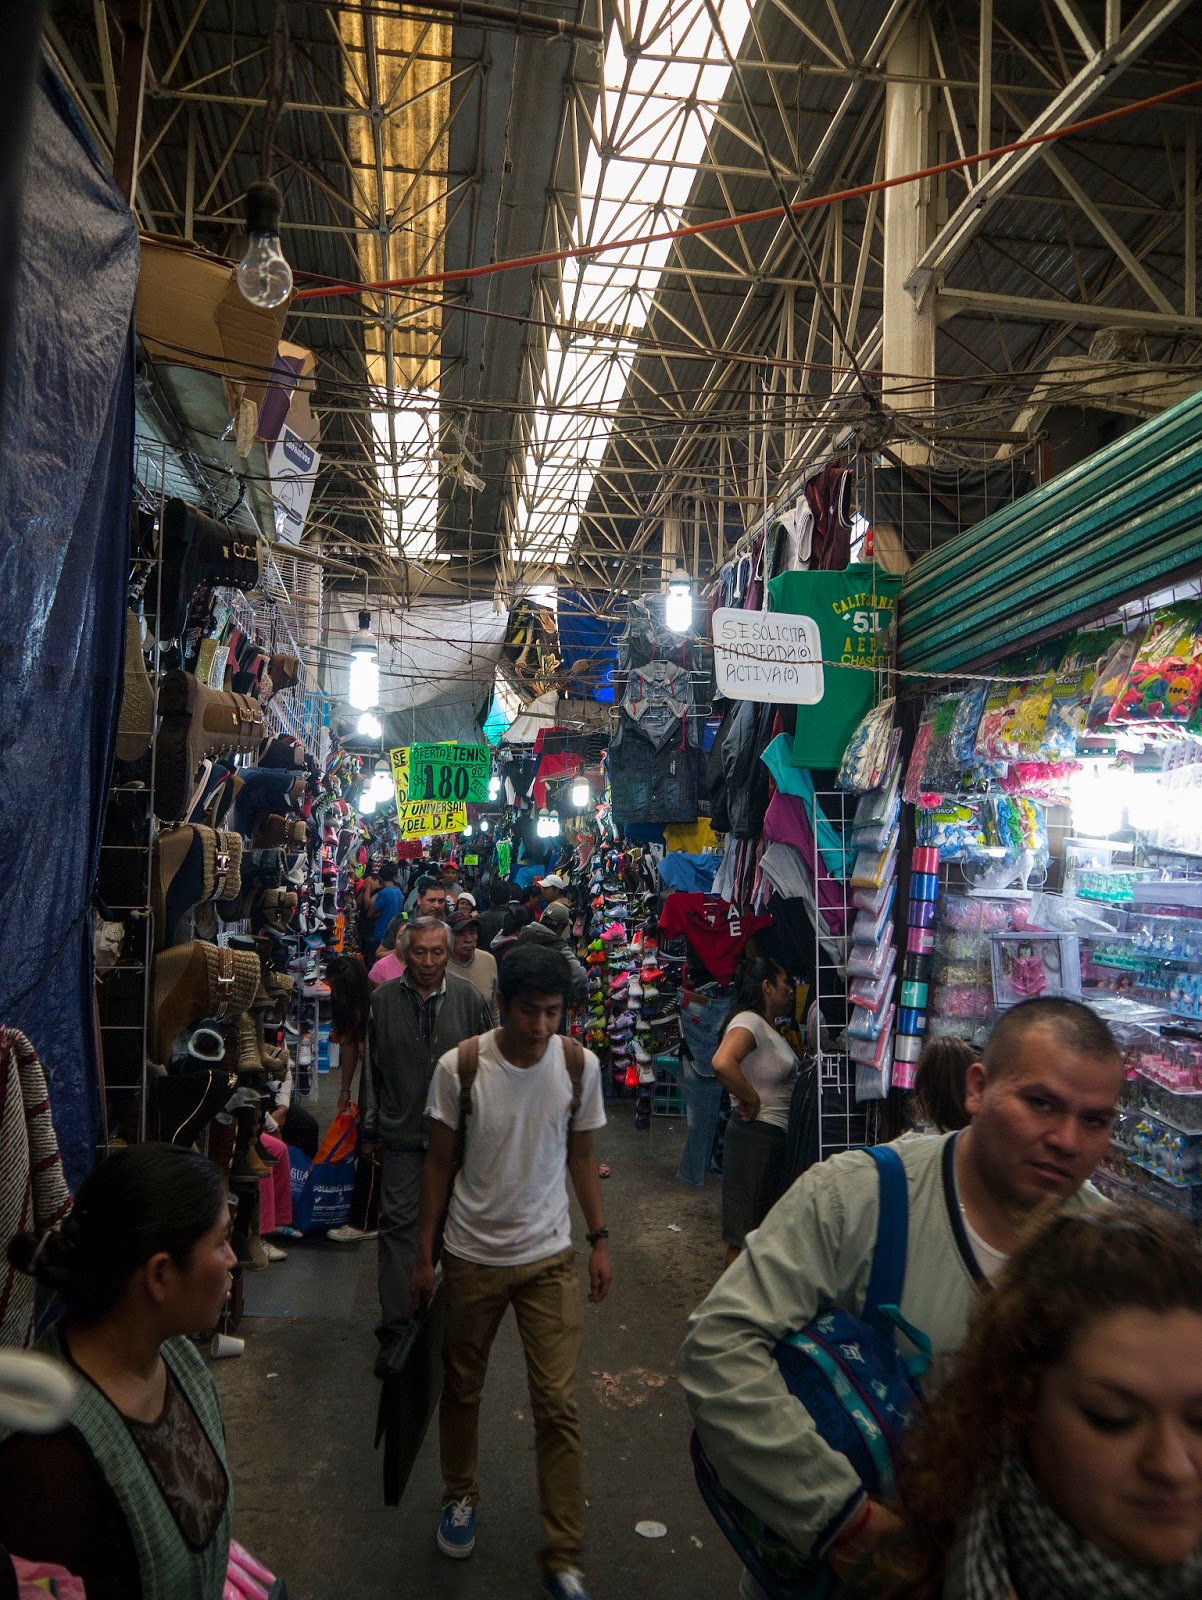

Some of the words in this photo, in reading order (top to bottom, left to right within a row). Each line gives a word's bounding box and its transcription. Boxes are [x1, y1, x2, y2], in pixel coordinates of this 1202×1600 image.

[832, 593, 894, 614] CALIFORNI
[721, 620, 749, 639] SE
[752, 623, 807, 643] SOLICITA
[413, 748, 446, 760] OFERTA
[453, 746, 487, 763] TENIS
[470, 780, 488, 798] PESOS
[411, 801, 464, 816] UNIVERSAL
